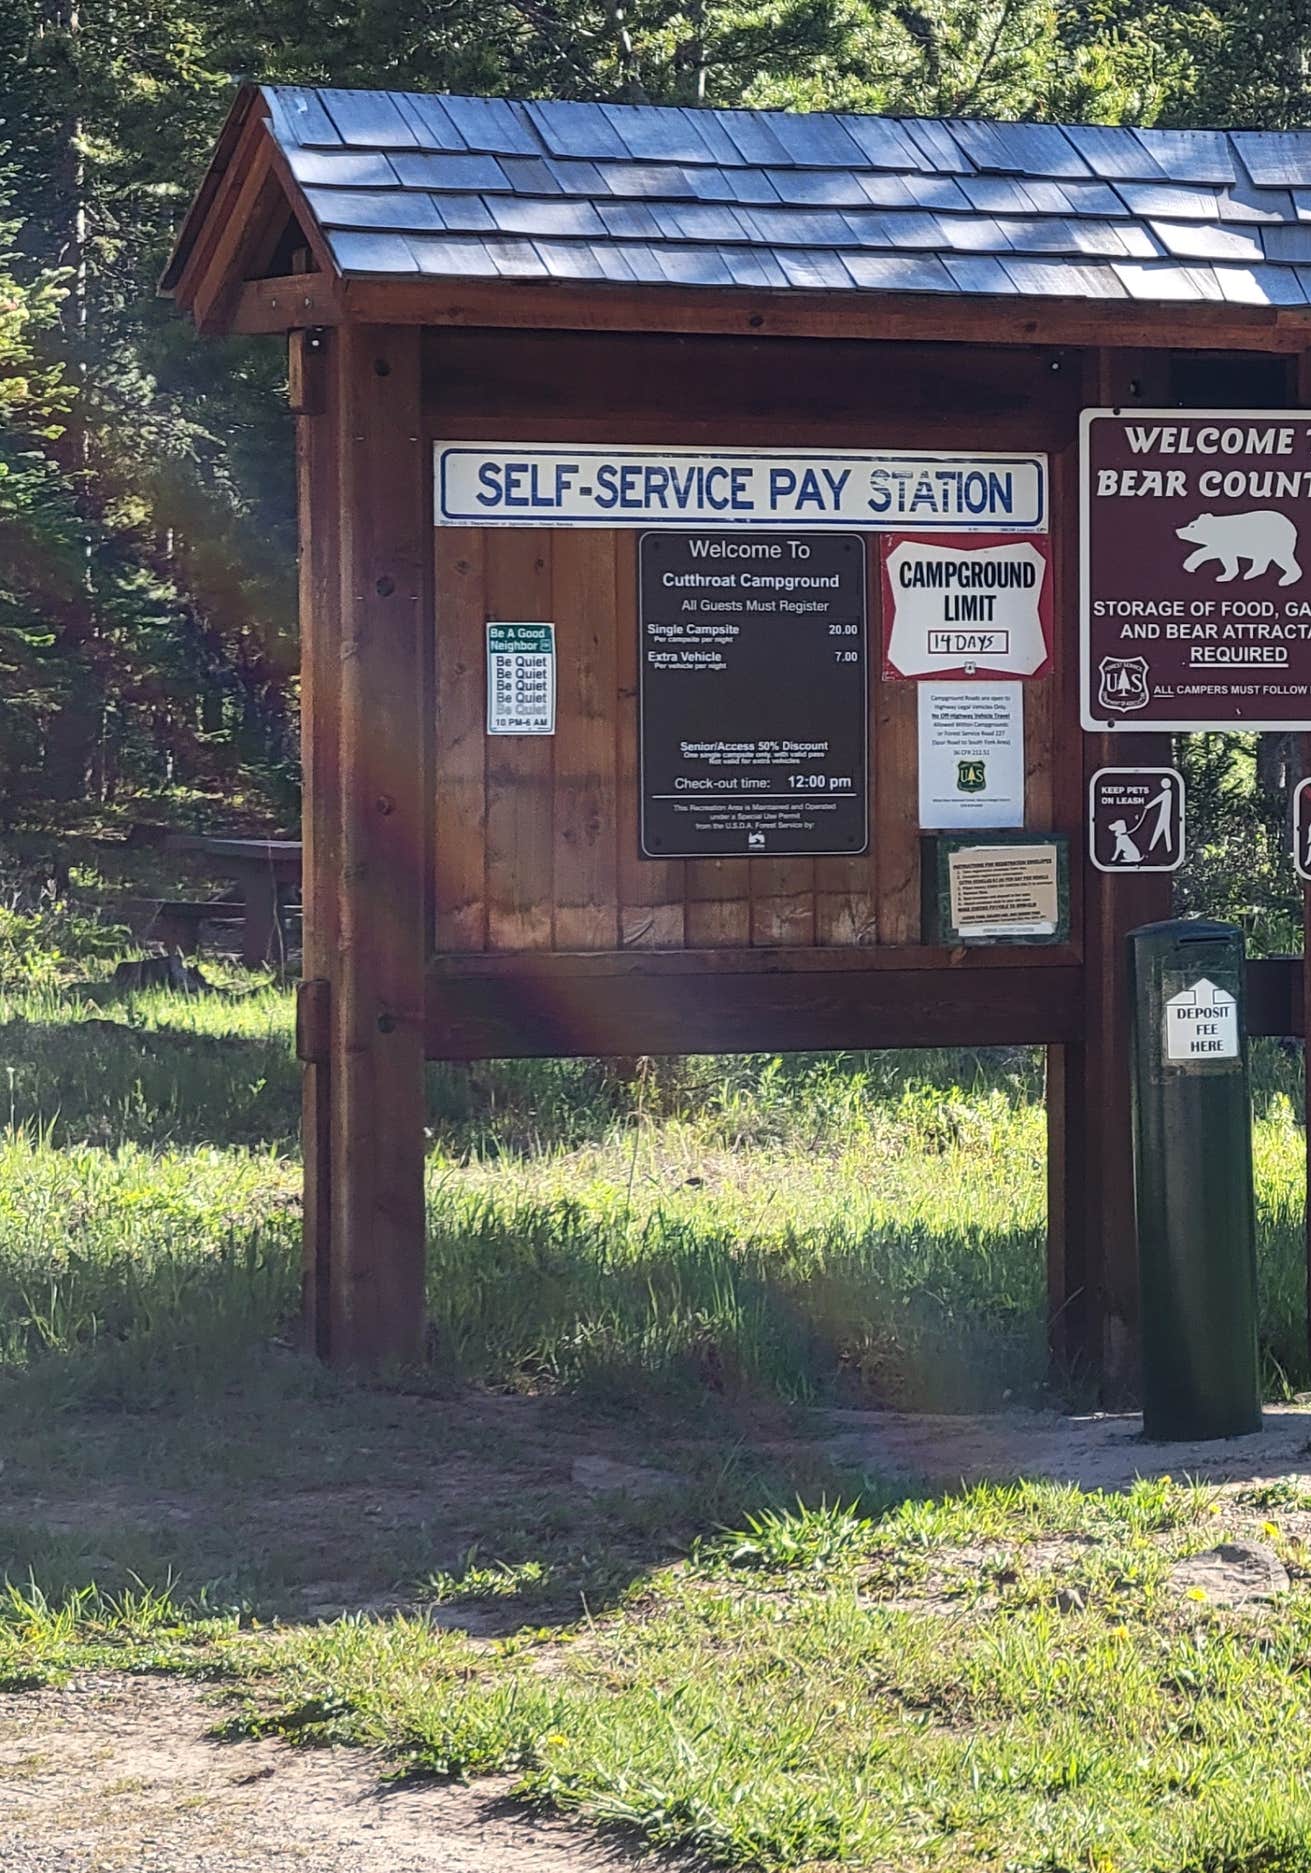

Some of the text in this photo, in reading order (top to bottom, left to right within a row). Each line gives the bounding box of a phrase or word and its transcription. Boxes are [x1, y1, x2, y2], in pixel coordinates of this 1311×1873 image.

[1125, 427, 1294, 454] WELCOME
[476, 462, 1013, 514] SELF-SERVICE PAY STATION
[1097, 470, 1187, 497] BEAR
[689, 540, 811, 559] Welcome To
[900, 561, 1036, 588] CAMPGROUND
[662, 573, 839, 590] Cutthroat Campground
[681, 600, 829, 614] All Guests Must Register
[944, 595, 997, 621] LIMIT
[1094, 601, 1185, 617] STORAGE
[1190, 601, 1215, 617] OF
[1221, 601, 1279, 619] FOOD,
[490, 628, 545, 638] Be A Good
[647, 624, 858, 636] Single Campsite 20.00
[1120, 624, 1160, 639] AND
[1166, 624, 1218, 639] BEAR
[490, 641, 538, 652] Neighbor
[935, 634, 995, 651] 14 DAYS
[648, 651, 858, 662] Extra Vehicle 7.00
[1190, 647, 1288, 662] REQUIRED
[496, 656, 547, 667] Be Quiet
[496, 668, 547, 679] Be Quiet
[496, 680, 547, 691] Be Quiet
[1154, 685, 1174, 695] ALL
[1177, 685, 1228, 695] CAMPERS
[1231, 685, 1260, 695] MUST
[1263, 685, 1307, 695] FOLLOW
[496, 692, 547, 703] Be Quiet
[680, 741, 829, 751] Senior/Access 50% Discount
[674, 775, 852, 790] Check-out time: 12:00 pm
[1101, 786, 1150, 794] KEEP PETS
[1177, 1006, 1229, 1019] DEPOSIT
[1196, 1024, 1218, 1035] FEE
[1190, 1040, 1224, 1052] HERE
